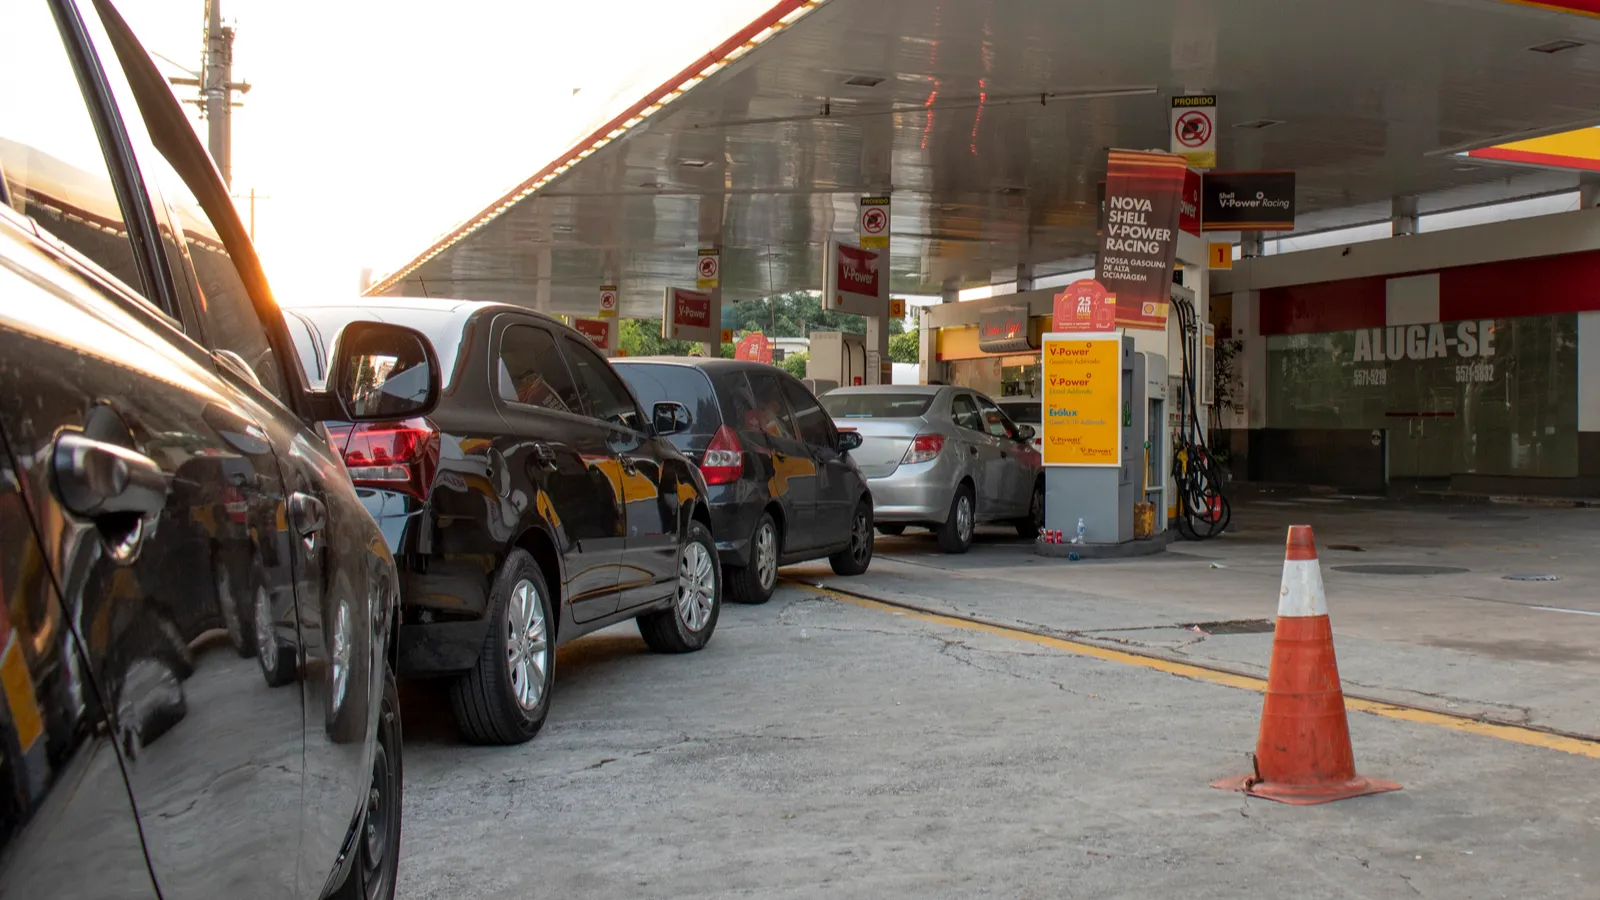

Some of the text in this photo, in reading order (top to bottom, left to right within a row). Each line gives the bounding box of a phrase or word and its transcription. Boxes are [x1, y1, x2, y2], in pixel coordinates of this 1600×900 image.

[1174, 97, 1214, 106] PROIBIDO
[1110, 196, 1152, 212] NOVA
[1219, 199, 1290, 210] V-Power Racing
[1108, 210, 1147, 226] SHELL
[1108, 224, 1171, 242] V-POWER
[1106, 238, 1159, 254] RACING
[1104, 256, 1166, 269] NOSSA GASOLINA
[1217, 248, 1224, 263] 1
[842, 265, 874, 285] V-Power
[1102, 271, 1147, 281] OCTANAGEM
[1103, 264, 1130, 273] DE ALTA
[1078, 296, 1091, 306] 25
[678, 303, 706, 319] V-Power
[1076, 305, 1091, 313] MIL
[1353, 319, 1496, 362] ALUGA-SE
[1049, 347, 1090, 356] V-Power
[1353, 368, 1387, 386] 5571-5219
[1455, 364, 1494, 382] 5571-5832
[1049, 378, 1090, 387] V-Power
